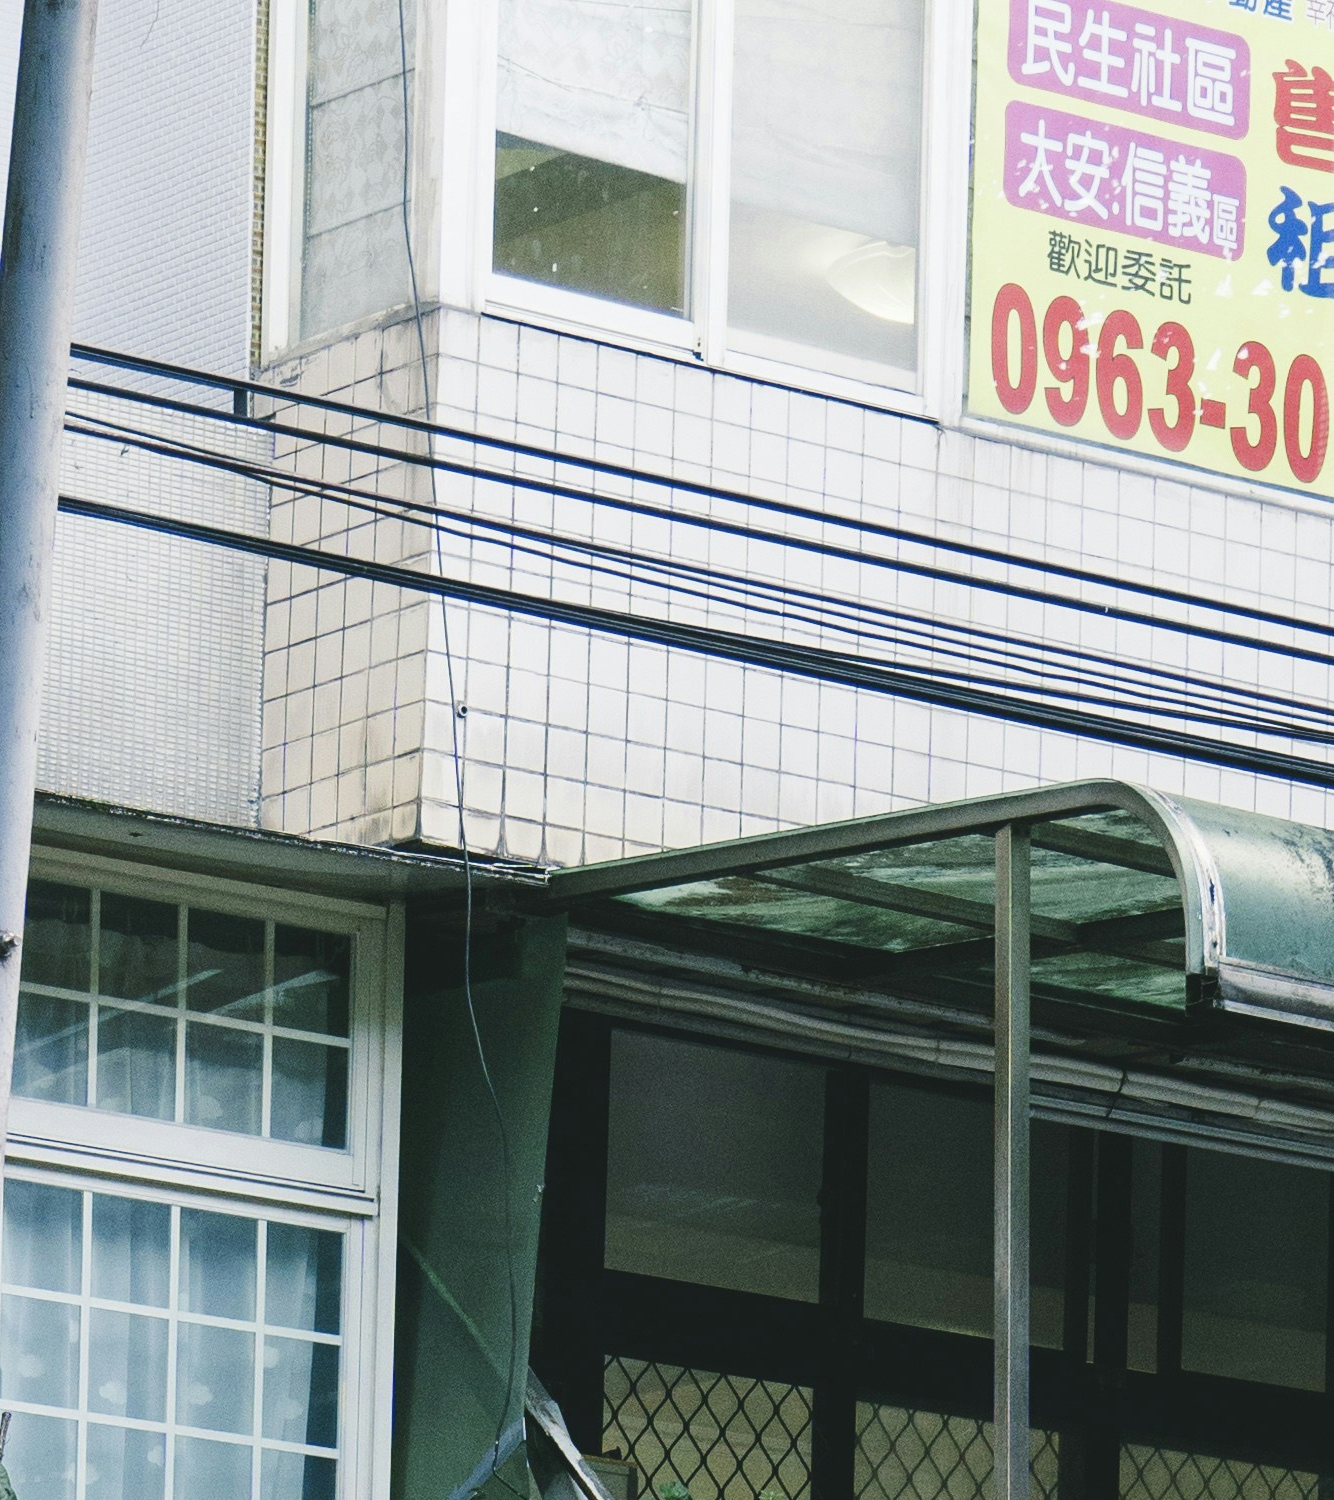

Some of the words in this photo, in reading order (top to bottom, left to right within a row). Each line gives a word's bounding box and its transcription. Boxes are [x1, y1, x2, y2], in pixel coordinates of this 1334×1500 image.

[1021, 2, 1237, 127] 民生社區
[1047, 229, 1192, 305] 歡迎委託
